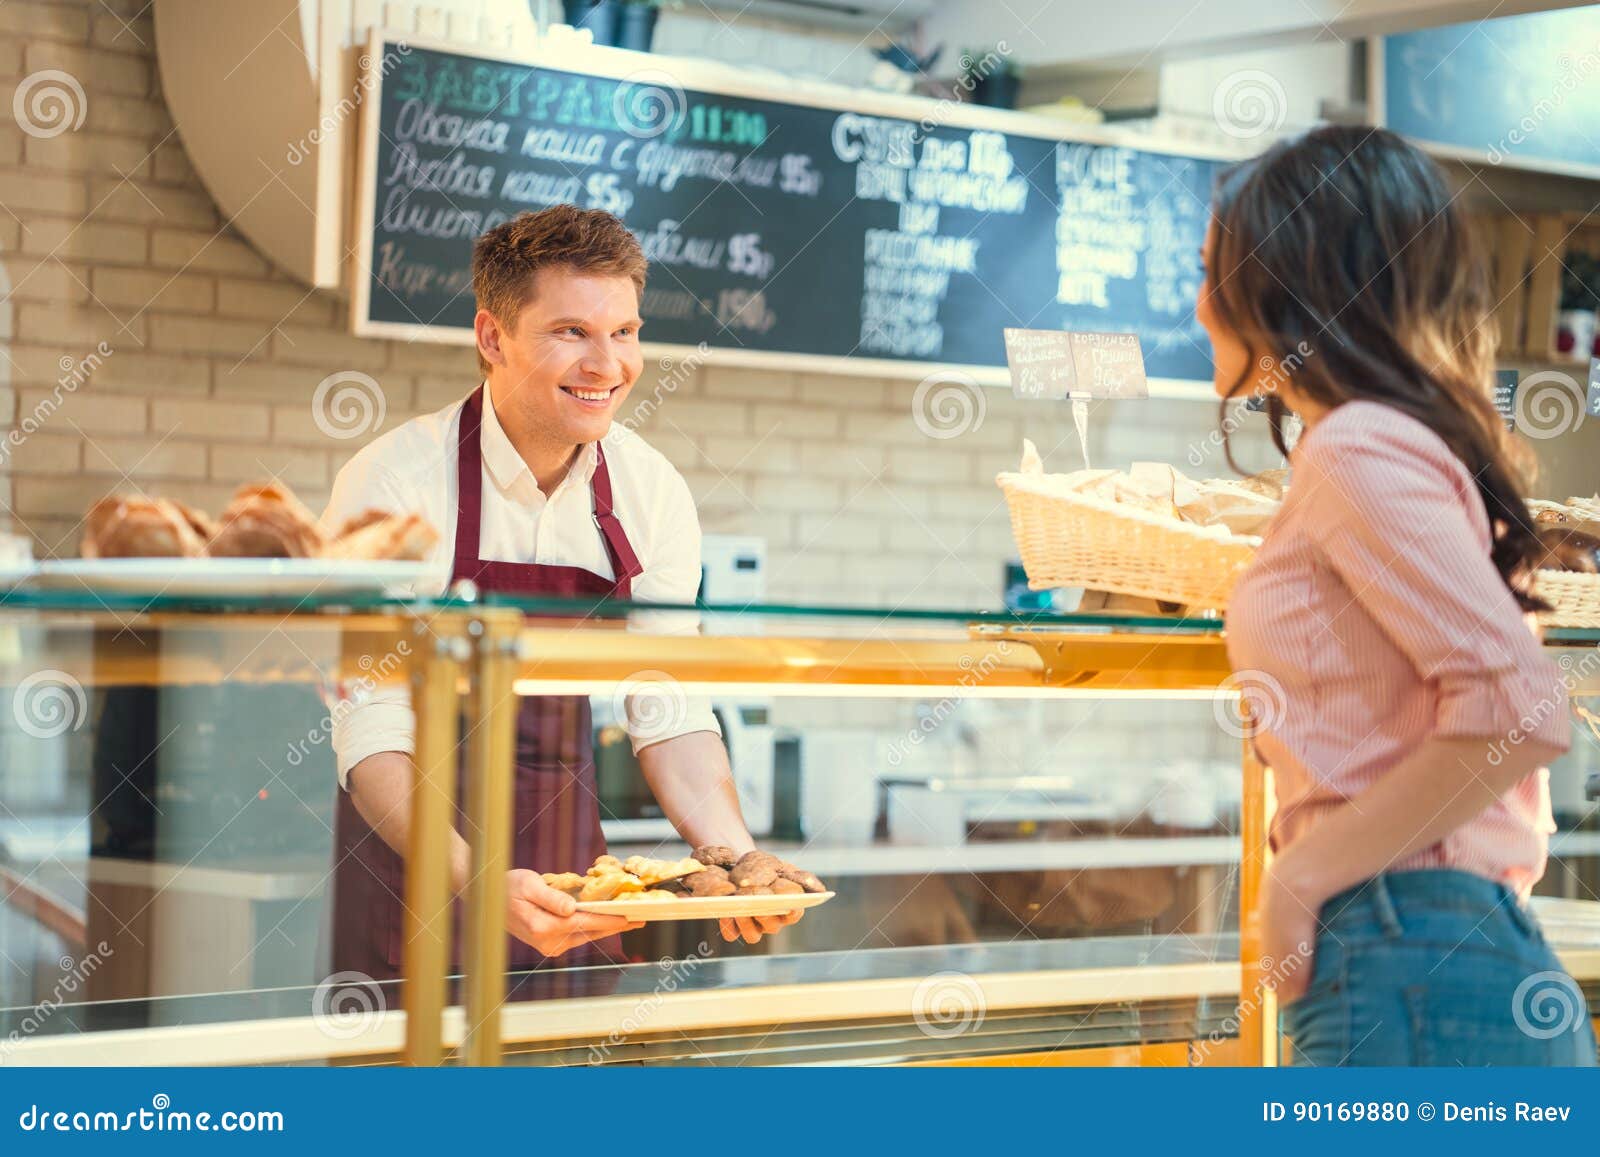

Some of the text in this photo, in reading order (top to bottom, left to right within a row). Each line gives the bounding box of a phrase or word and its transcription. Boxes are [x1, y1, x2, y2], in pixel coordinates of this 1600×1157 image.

[394, 97, 510, 154] Овсяная
[521, 126, 608, 165] каша
[500, 169, 582, 206] каша
